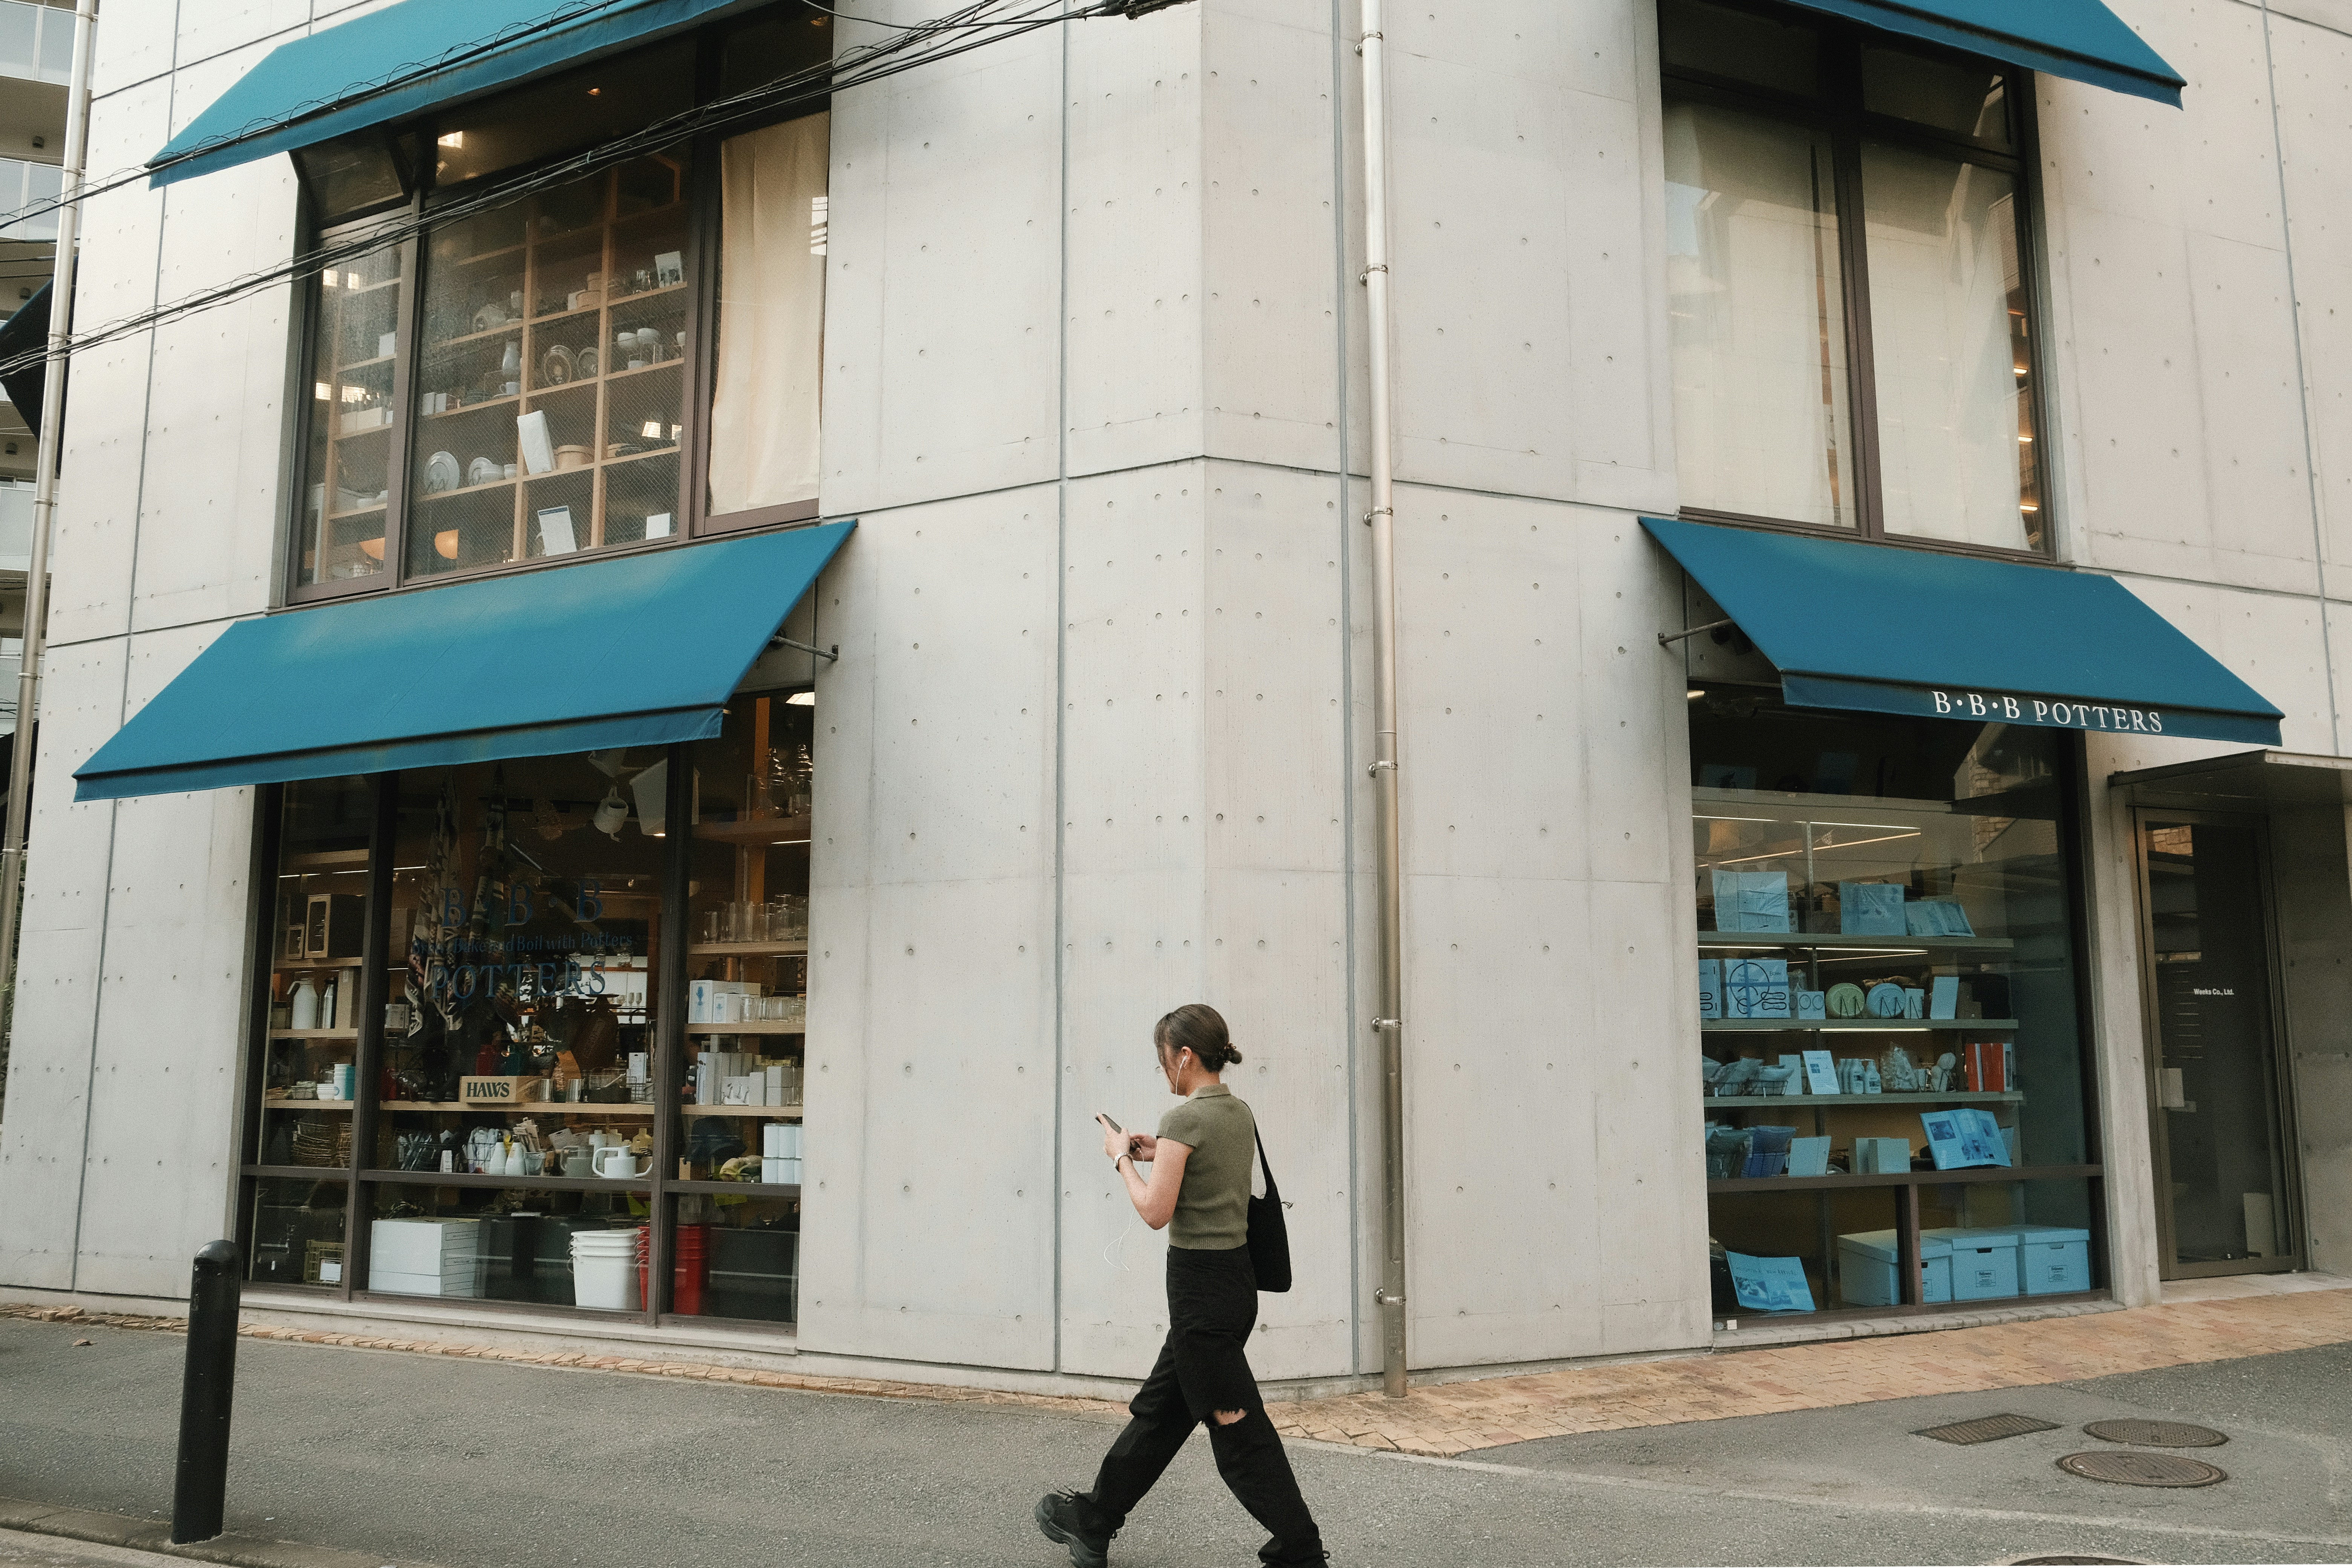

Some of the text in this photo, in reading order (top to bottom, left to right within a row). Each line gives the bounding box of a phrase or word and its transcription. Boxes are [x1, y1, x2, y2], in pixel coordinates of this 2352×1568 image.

[2033, 700, 2162, 732] POTTERS
[517, 935, 543, 951] Boil
[546, 934, 575, 950] with
[580, 931, 632, 947] Potters
[431, 960, 606, 999] POTTERS
[466, 1081, 510, 1098] HAWS
